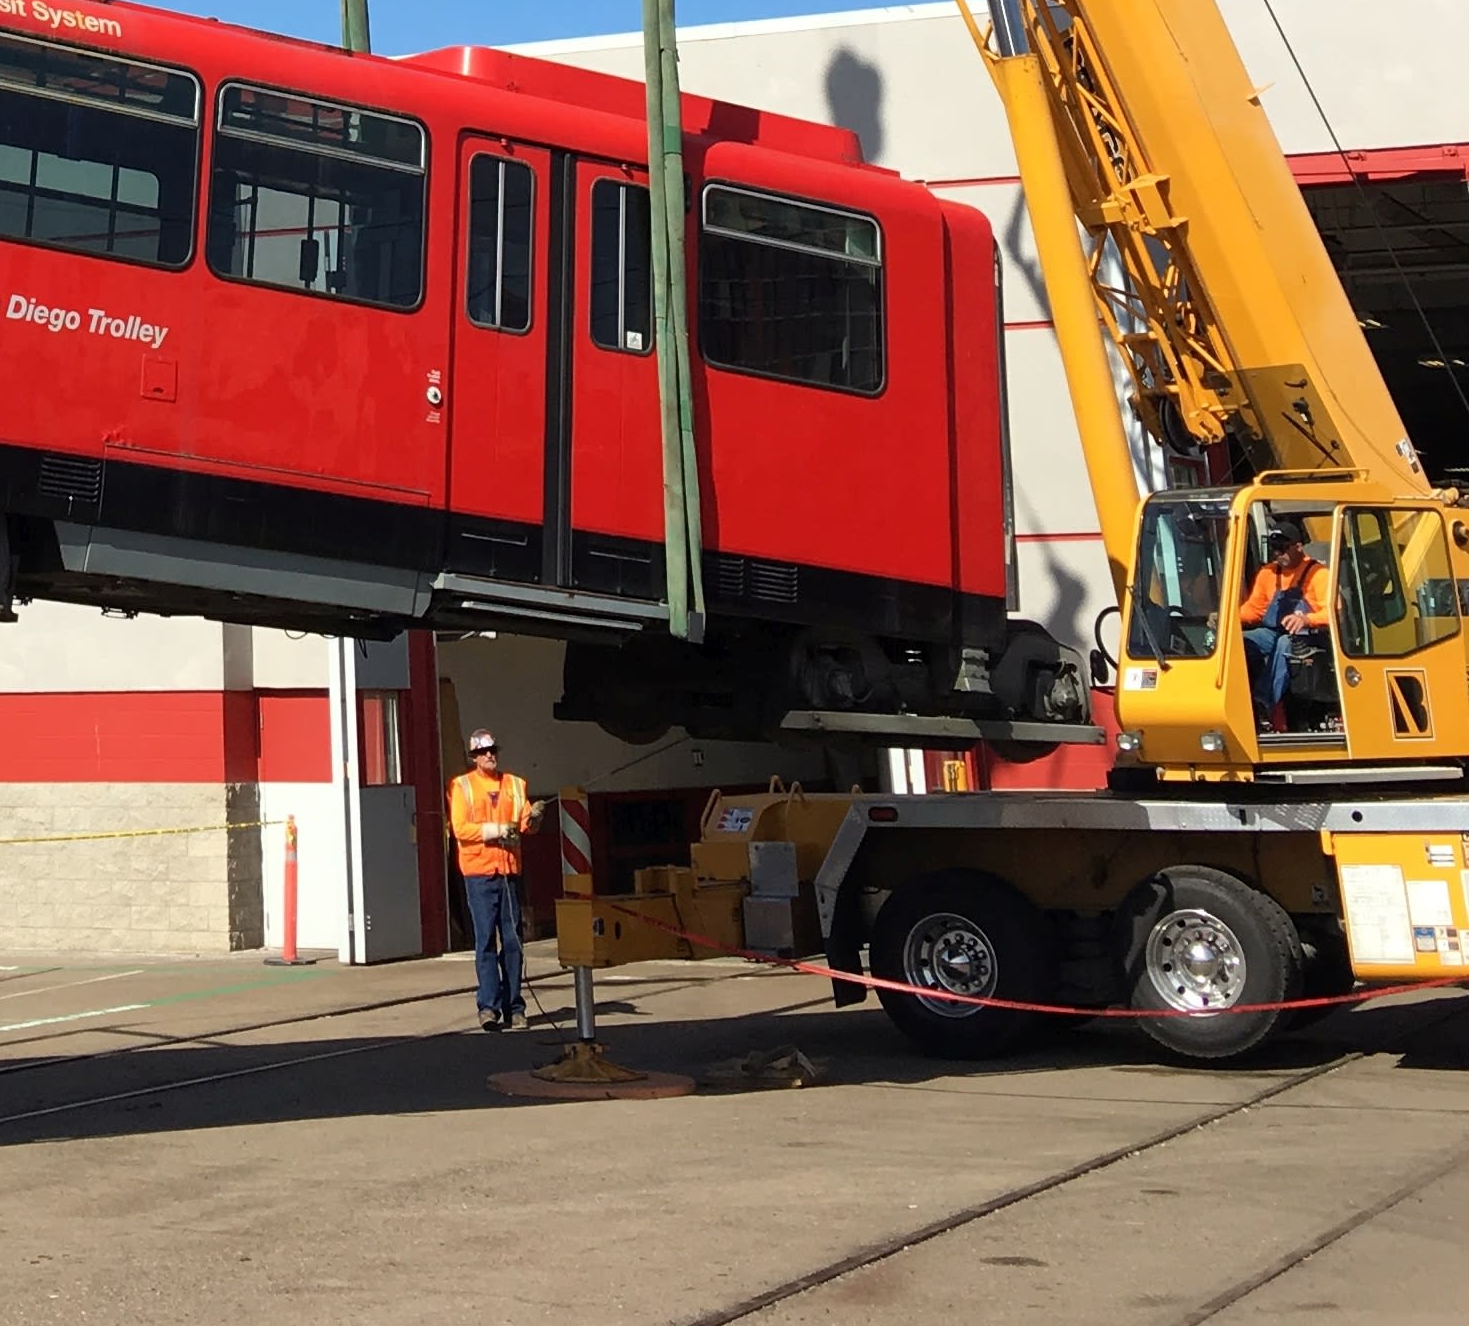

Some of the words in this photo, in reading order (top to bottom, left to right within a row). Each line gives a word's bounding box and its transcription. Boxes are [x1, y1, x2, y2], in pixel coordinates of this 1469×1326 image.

[31, 0, 122, 38] System
[6, 294, 81, 333] Diego
[85, 309, 169, 350] Trolley
